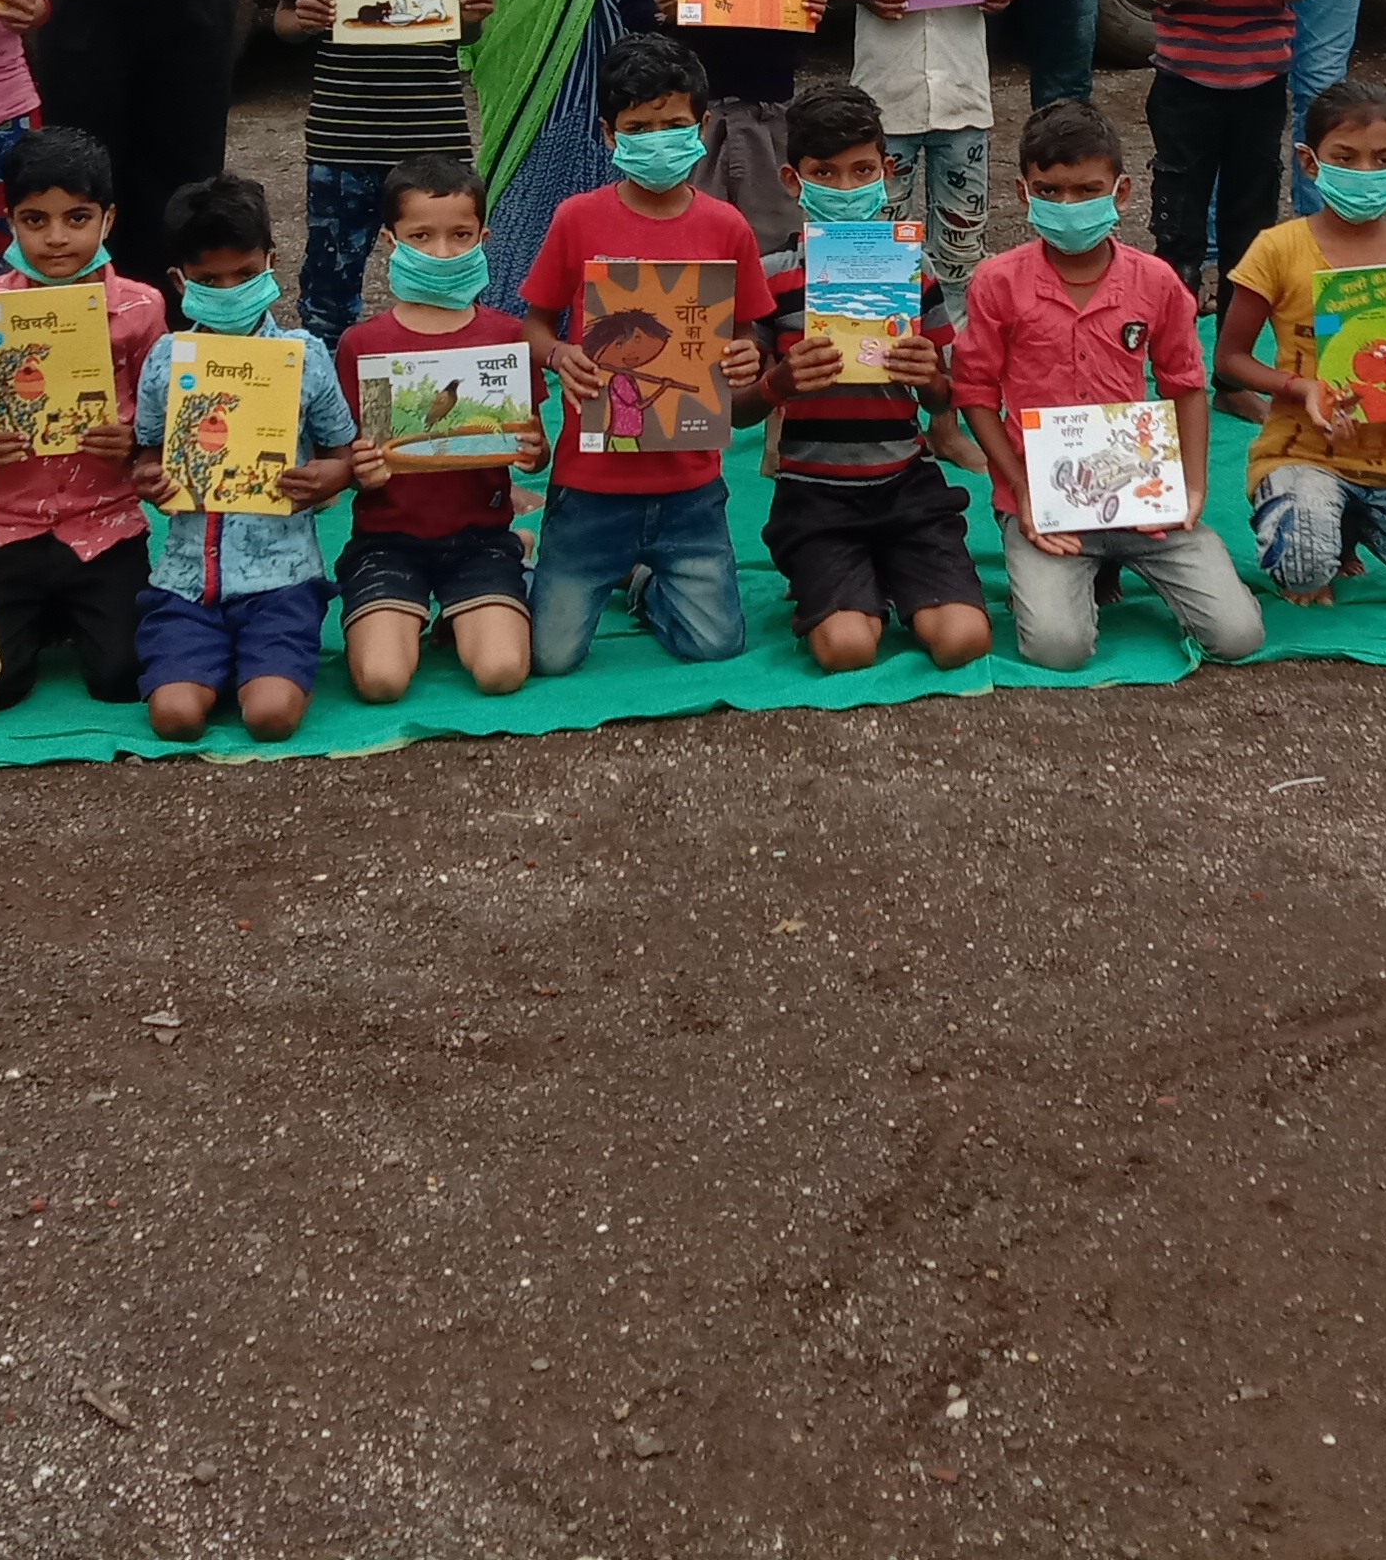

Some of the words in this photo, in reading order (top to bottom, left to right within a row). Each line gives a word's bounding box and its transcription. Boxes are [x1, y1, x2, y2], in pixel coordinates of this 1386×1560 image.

[674, 296, 711, 325] चाँद
[10, 311, 58, 332] खिचड़ी
[685, 326, 702, 340] का
[679, 341, 706, 361] घर
[206, 360, 254, 380] खिचड़ी
[476, 353, 518, 371] प्यासी
[479, 372, 508, 388] मैना
